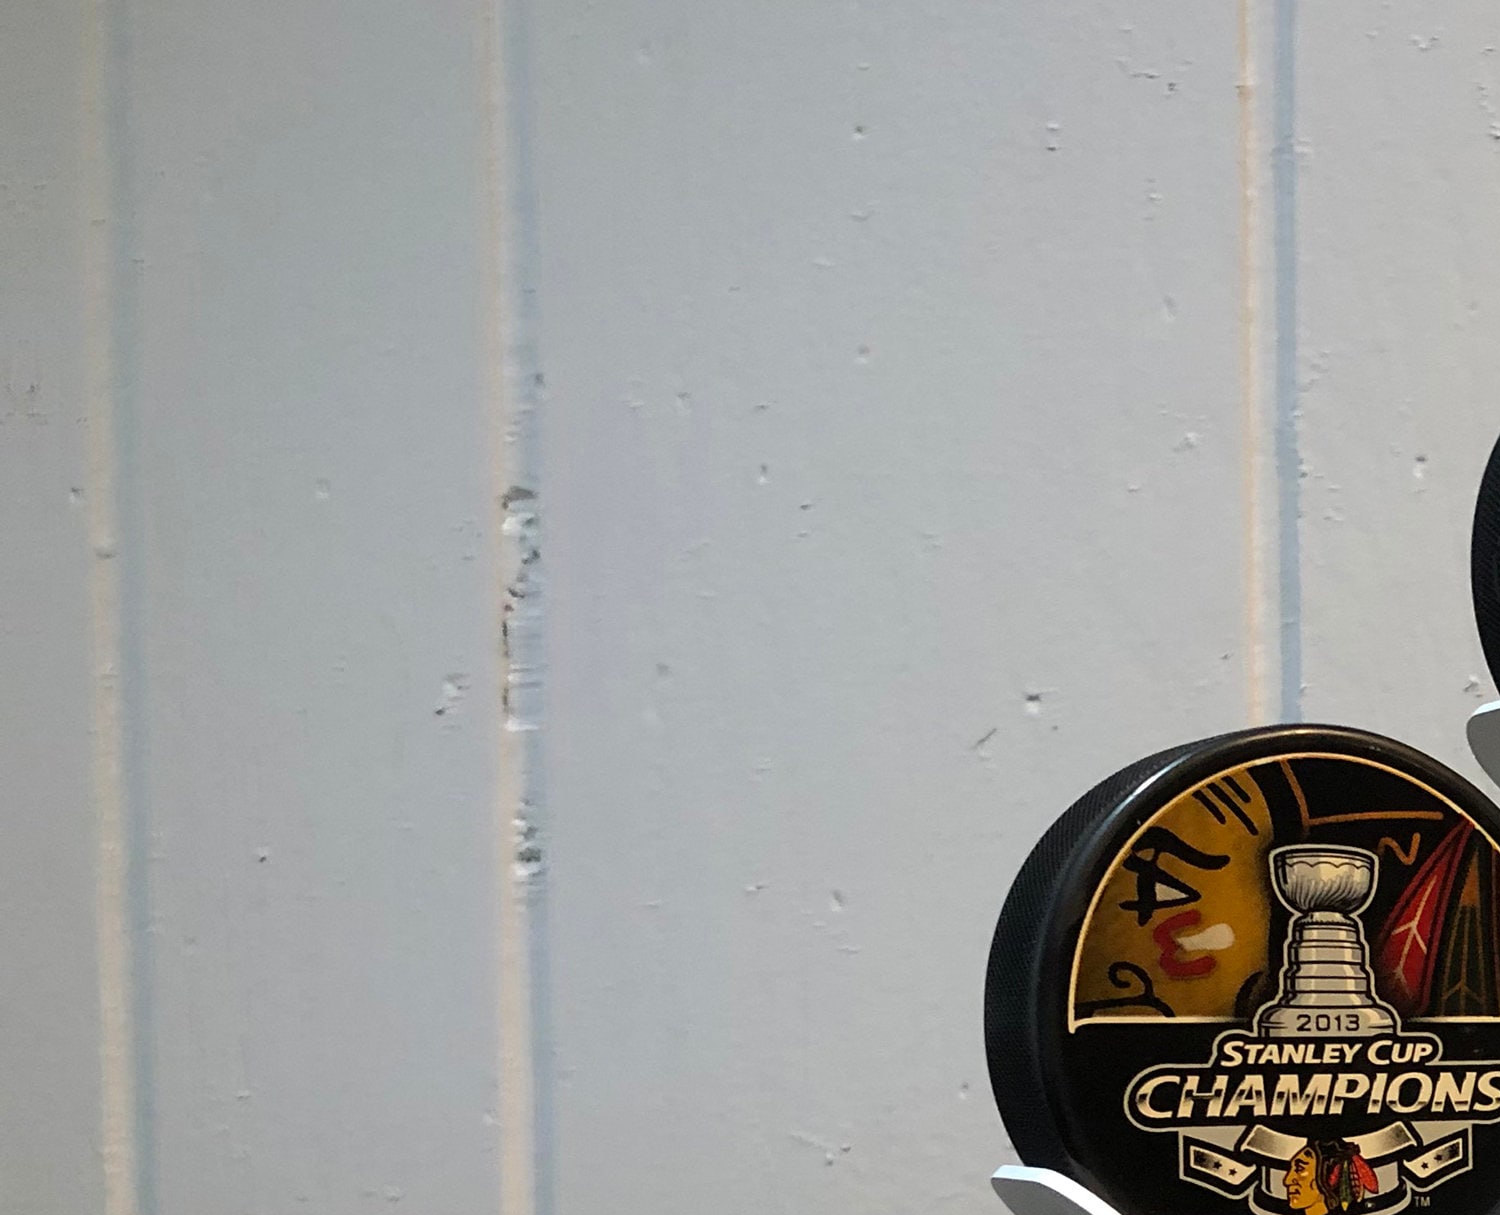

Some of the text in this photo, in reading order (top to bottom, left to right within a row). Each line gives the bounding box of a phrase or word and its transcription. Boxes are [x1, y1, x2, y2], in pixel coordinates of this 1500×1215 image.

[1296, 1014, 1361, 1032] 2013
[1221, 1040, 1433, 1067] STANLEY CUP
